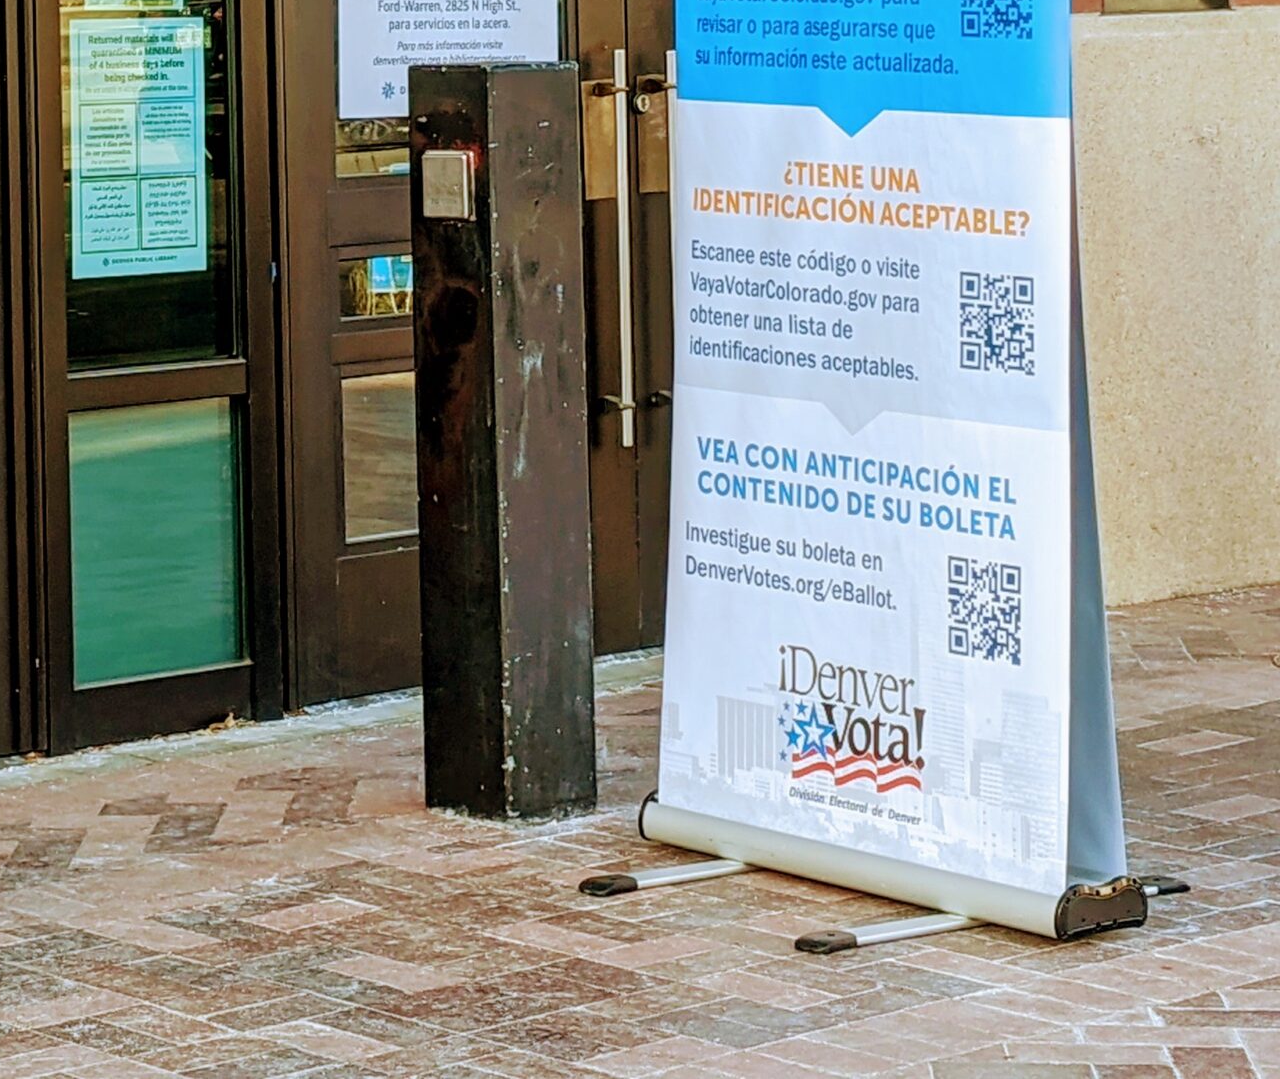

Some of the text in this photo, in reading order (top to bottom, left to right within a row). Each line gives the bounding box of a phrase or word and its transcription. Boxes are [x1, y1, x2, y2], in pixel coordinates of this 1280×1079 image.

[696, 14, 935, 43] revisar o para asegurarse que
[695, 47, 959, 74] su información este actualizada.
[784, 161, 920, 193] ¿TIENE UNA
[692, 188, 1031, 236] IDENTIFICACIÓN ACEPTABLE?
[691, 239, 920, 279] Escanee este código o visite
[690, 272, 919, 314] VayaVotarColorado.gov para
[689, 305, 853, 339] obtener una lista de
[689, 336, 918, 380] identificaciones aceptables.
[697, 436, 1017, 505] VEA CON ANTICIPACIÓN EL
[698, 470, 1016, 541] CONTENIDO DE SU BOLETA
[685, 521, 883, 571] Investigue su boleta en
[685, 554, 898, 611] DenverVotes.org/eBallot.
[822, 703, 927, 769] Vota!
[789, 786, 922, 825] División Electoral de Denver
